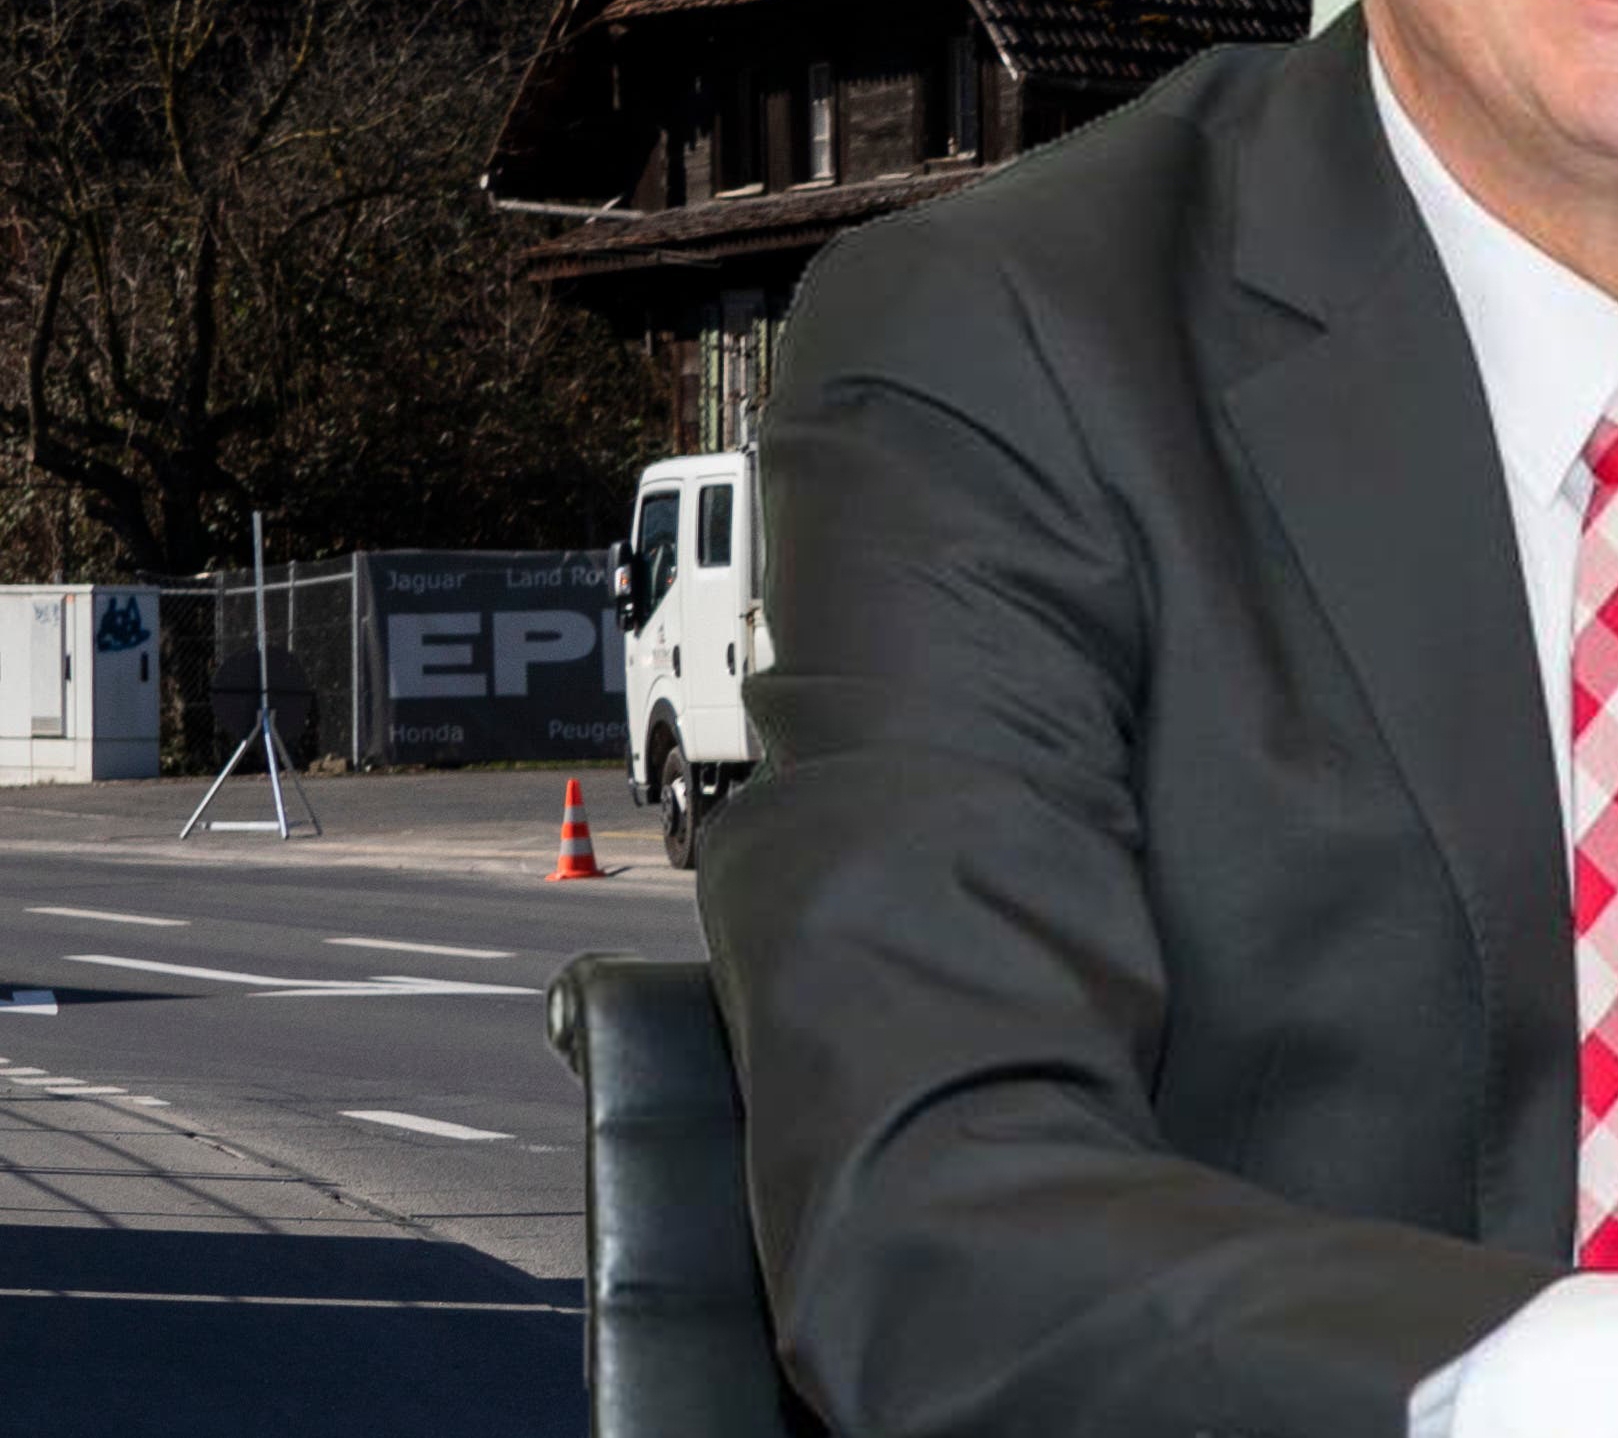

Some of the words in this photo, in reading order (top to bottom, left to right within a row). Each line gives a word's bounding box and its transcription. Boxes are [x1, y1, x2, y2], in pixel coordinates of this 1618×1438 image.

[387, 570, 465, 594] Jaguar
[506, 567, 561, 588] Land
[389, 724, 464, 744] Honda
